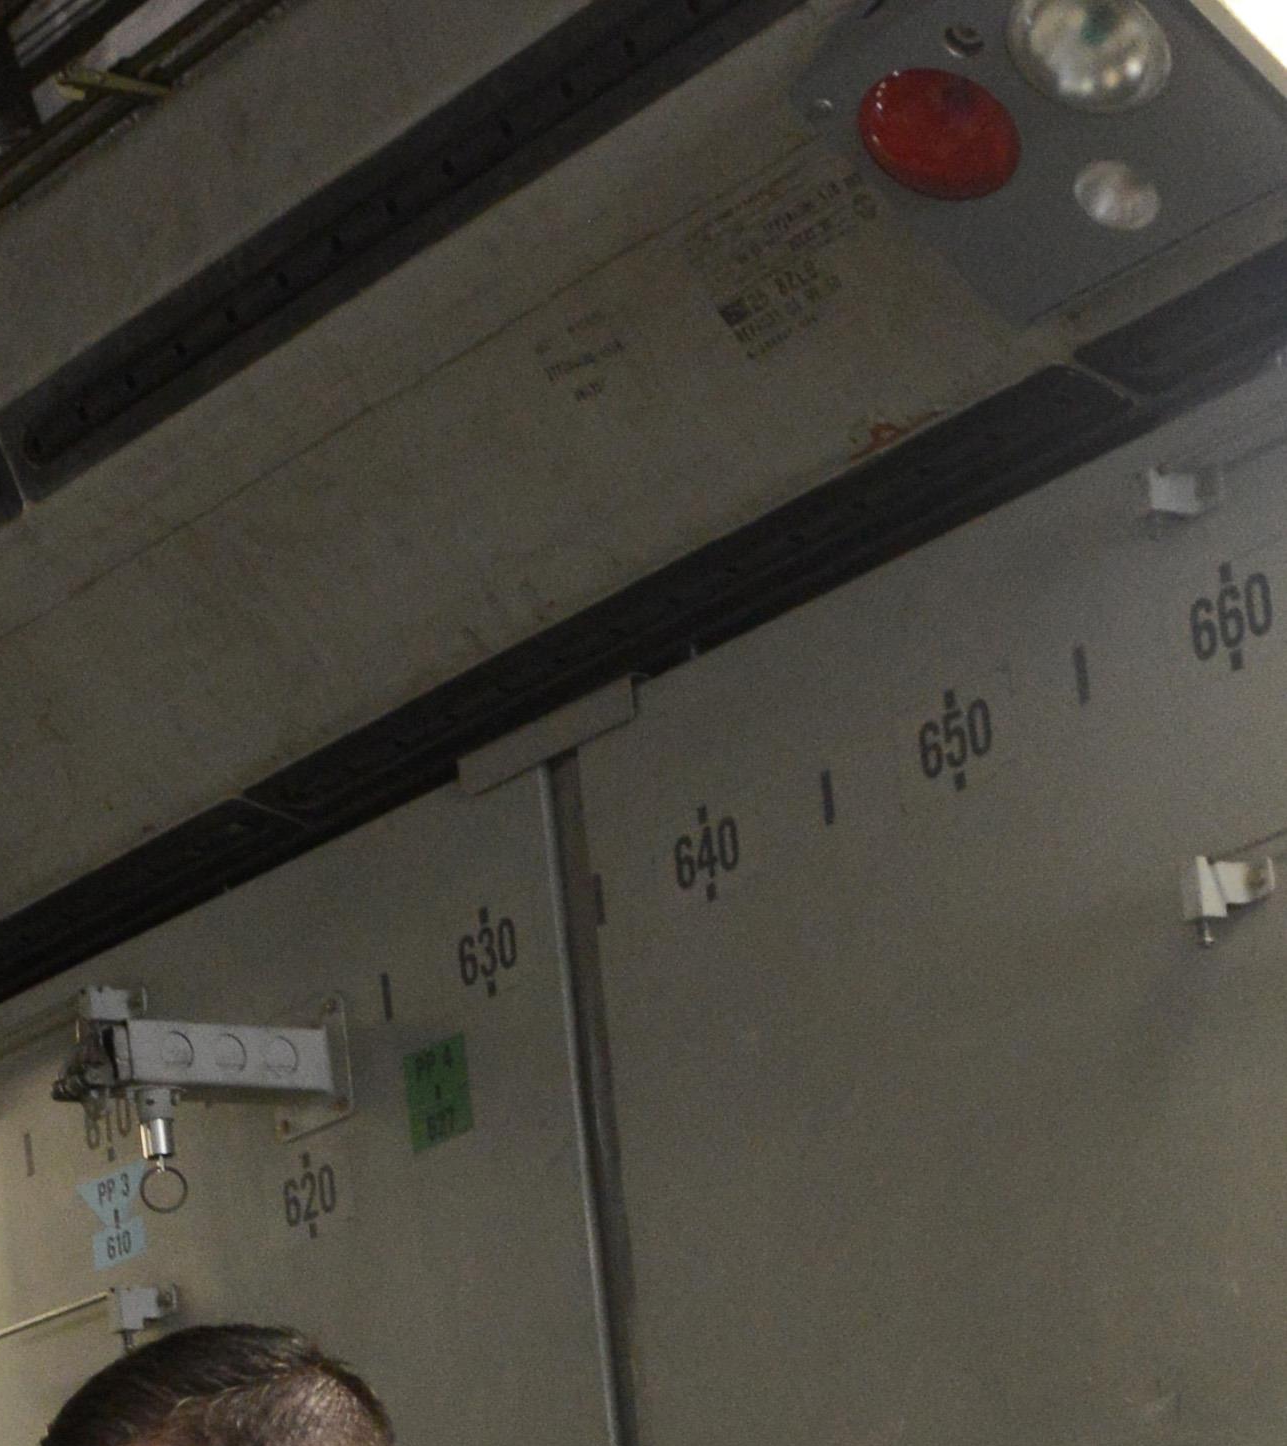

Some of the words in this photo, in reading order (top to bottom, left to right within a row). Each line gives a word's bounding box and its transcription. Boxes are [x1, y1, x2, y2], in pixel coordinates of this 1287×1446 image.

[1189, 571, 1274, 662] 660
[917, 697, 994, 781] 650
[673, 815, 740, 892] 640
[457, 917, 518, 987] 630
[97, 1177, 115, 1206] PP
[122, 1171, 131, 1197] 3
[283, 1163, 336, 1228] 620
[106, 1230, 133, 1260] 610
